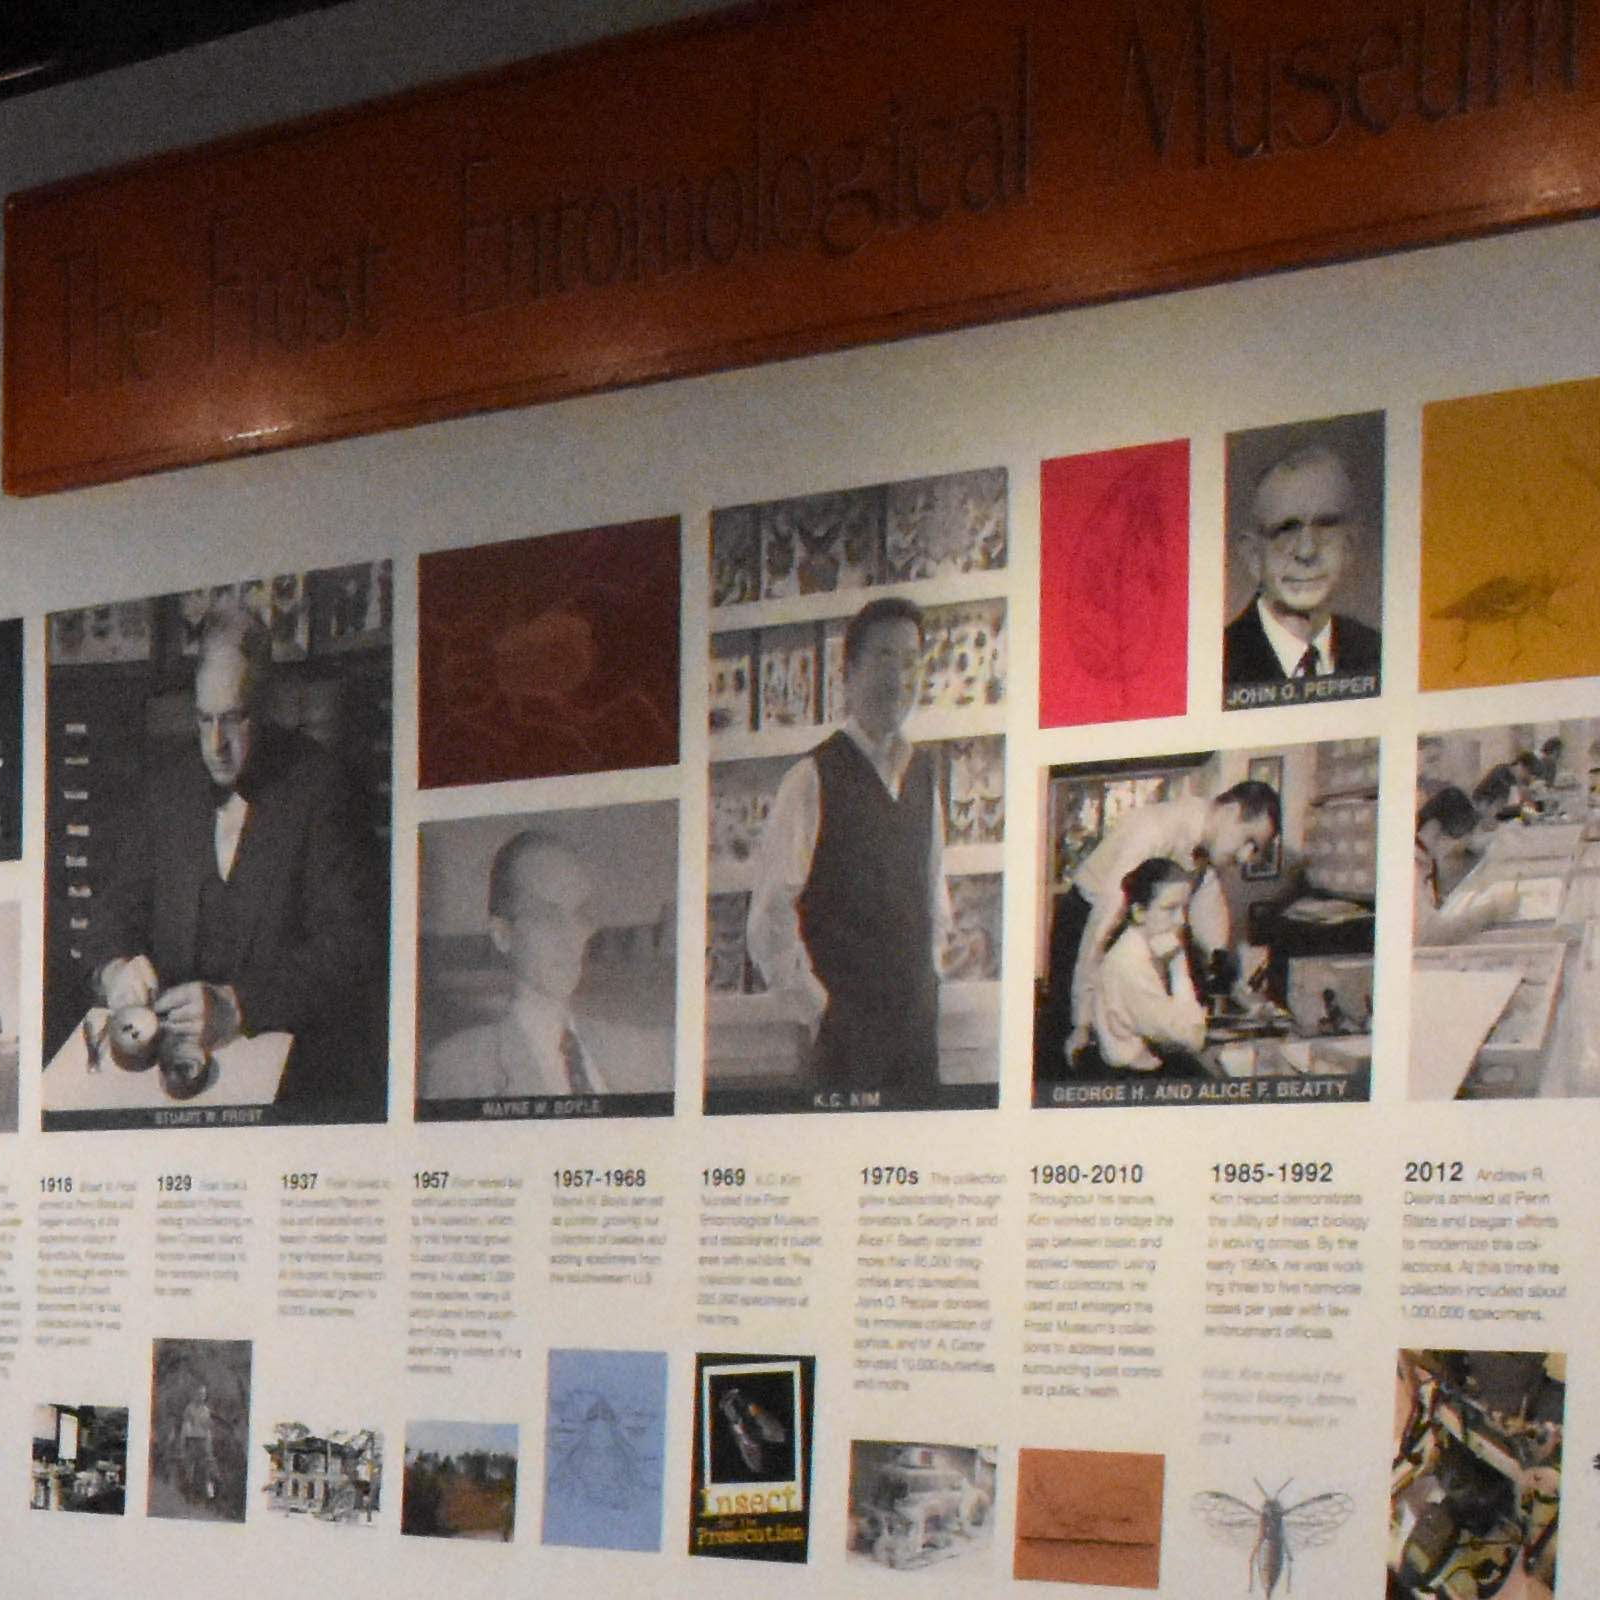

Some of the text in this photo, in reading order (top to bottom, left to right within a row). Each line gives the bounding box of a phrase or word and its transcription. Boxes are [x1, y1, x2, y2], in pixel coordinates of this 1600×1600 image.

[50, 0, 1578, 402] The Frost Entomological Museum
[1227, 685, 1276, 705] JOHN
[1304, 676, 1375, 700] PEPPER
[850, 1092, 881, 1107] KIM
[1053, 1086, 1125, 1103] GEORGE
[1155, 1085, 1192, 1101] AND
[1198, 1083, 1251, 1100] ALICE
[1277, 1080, 1347, 1098] BEATTY
[281, 1173, 318, 1190] 1937
[412, 1172, 449, 1189] 1957
[553, 1169, 646, 1188] 1957-1968
[702, 1168, 746, 1187] 1969
[860, 1166, 920, 1186] 1970s
[1029, 1164, 1143, 1185] 1980-2010
[1211, 1162, 1334, 1183] 1985-1992
[1404, 1161, 1464, 1183] 2012
[39, 1176, 73, 1194] 1918
[157, 1175, 192, 1191] 1929
